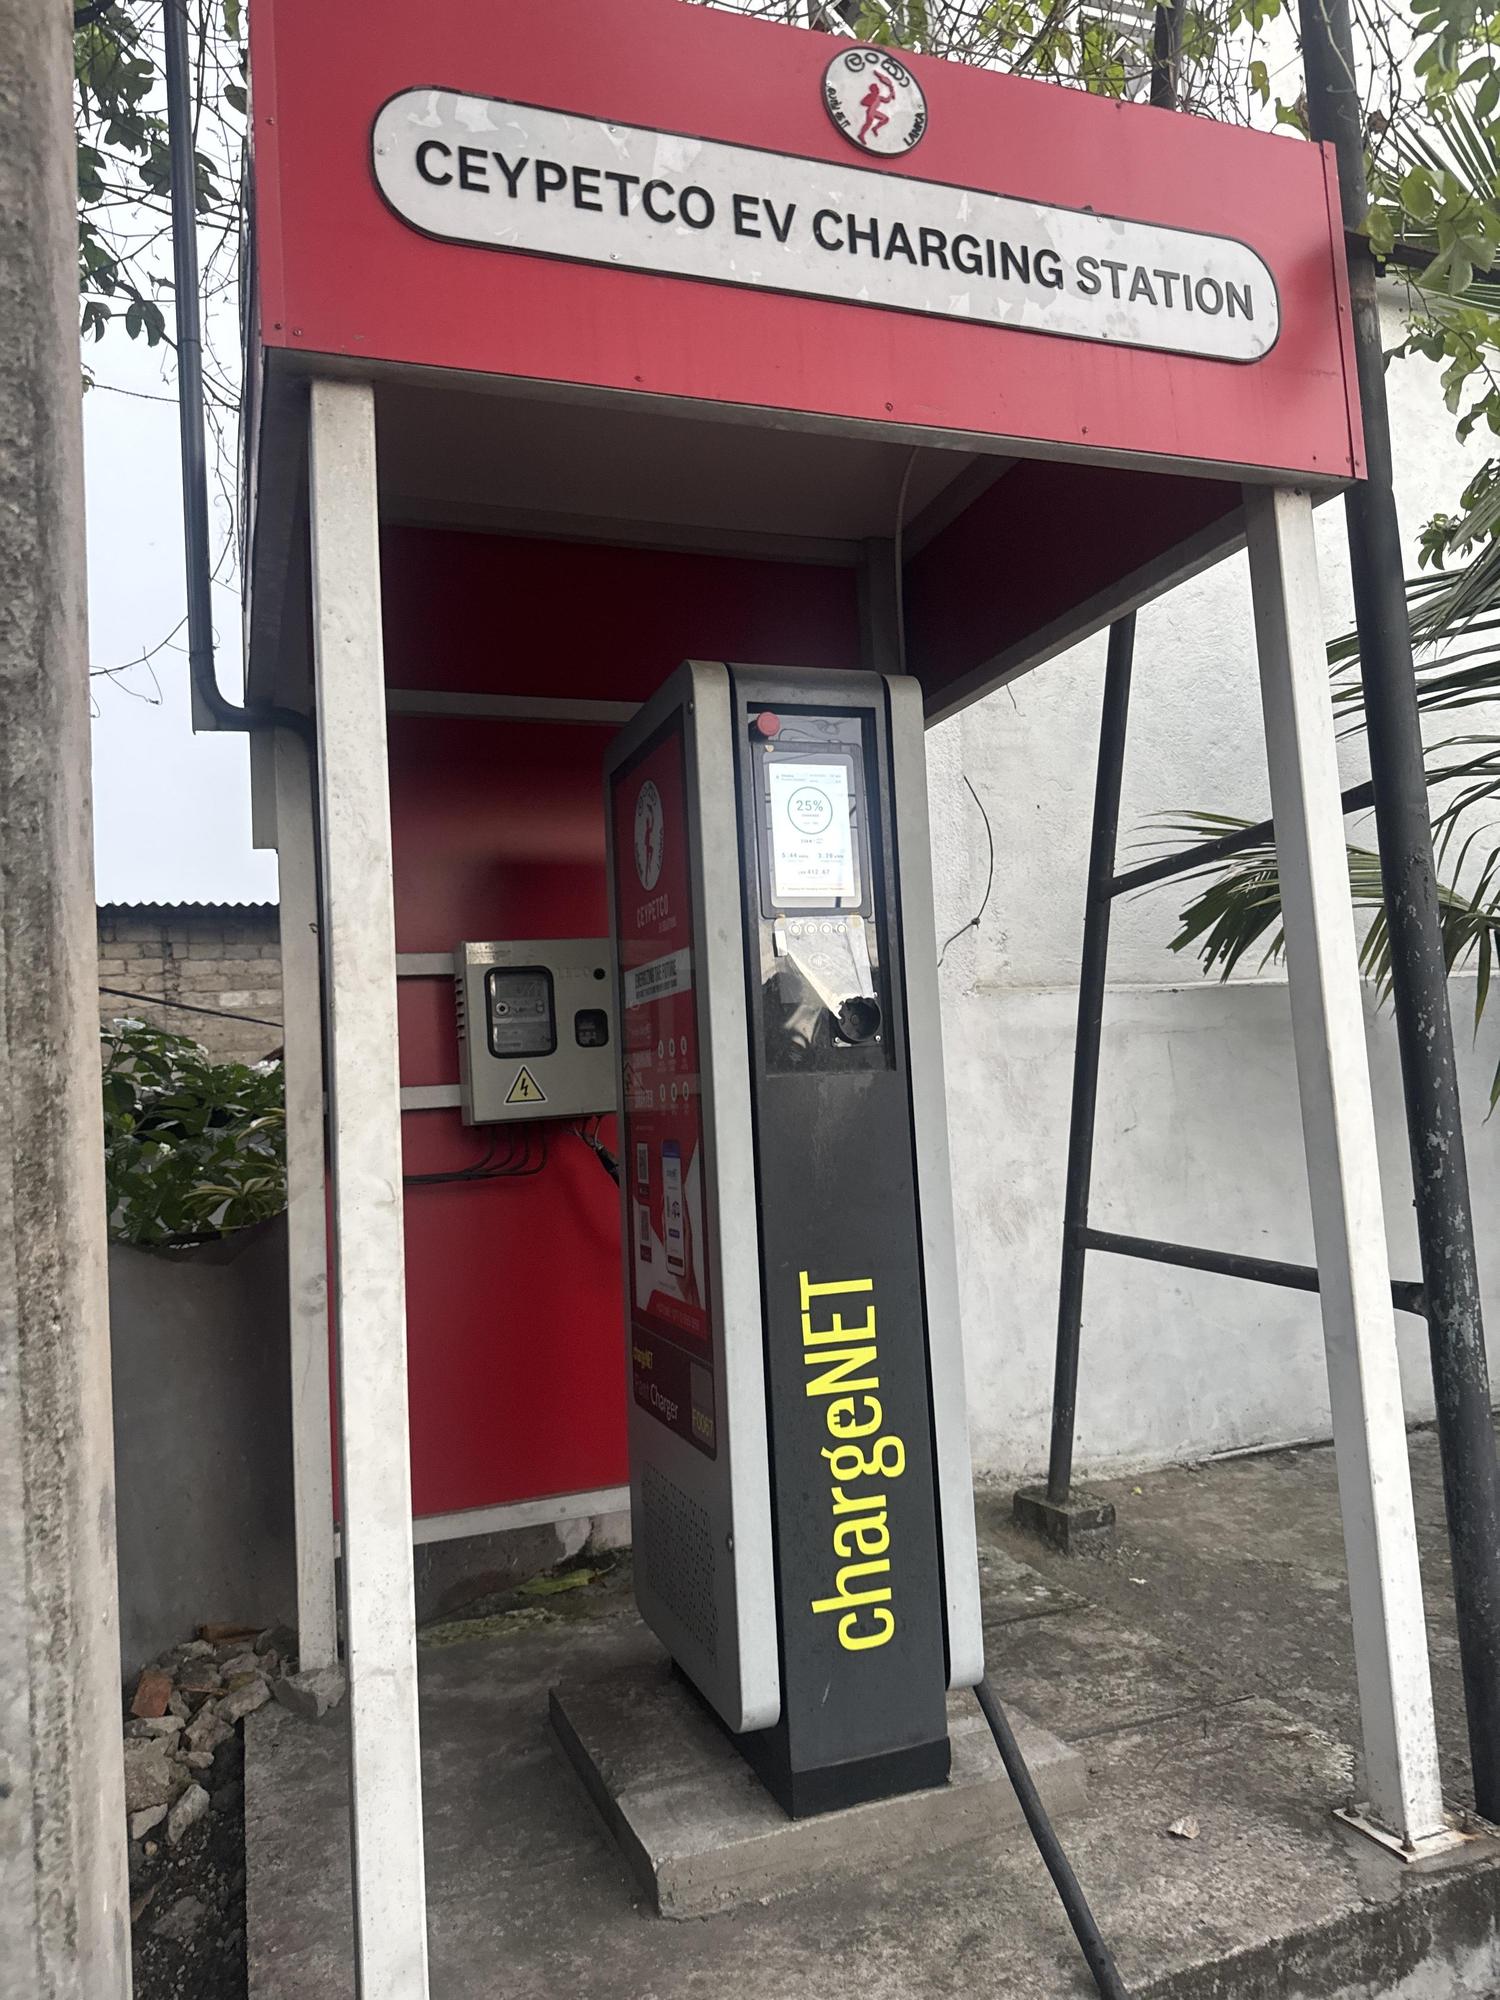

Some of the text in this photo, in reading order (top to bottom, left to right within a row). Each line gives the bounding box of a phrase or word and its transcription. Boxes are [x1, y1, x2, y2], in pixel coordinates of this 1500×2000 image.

[903, 112, 925, 147] LANKA
[415, 140, 1255, 321] CEYPETCO EV CHARGING STATION
[795, 800, 824, 812] 25%
[650, 1383, 678, 1421] Charger
[799, 1270, 906, 1651] chargeNET
